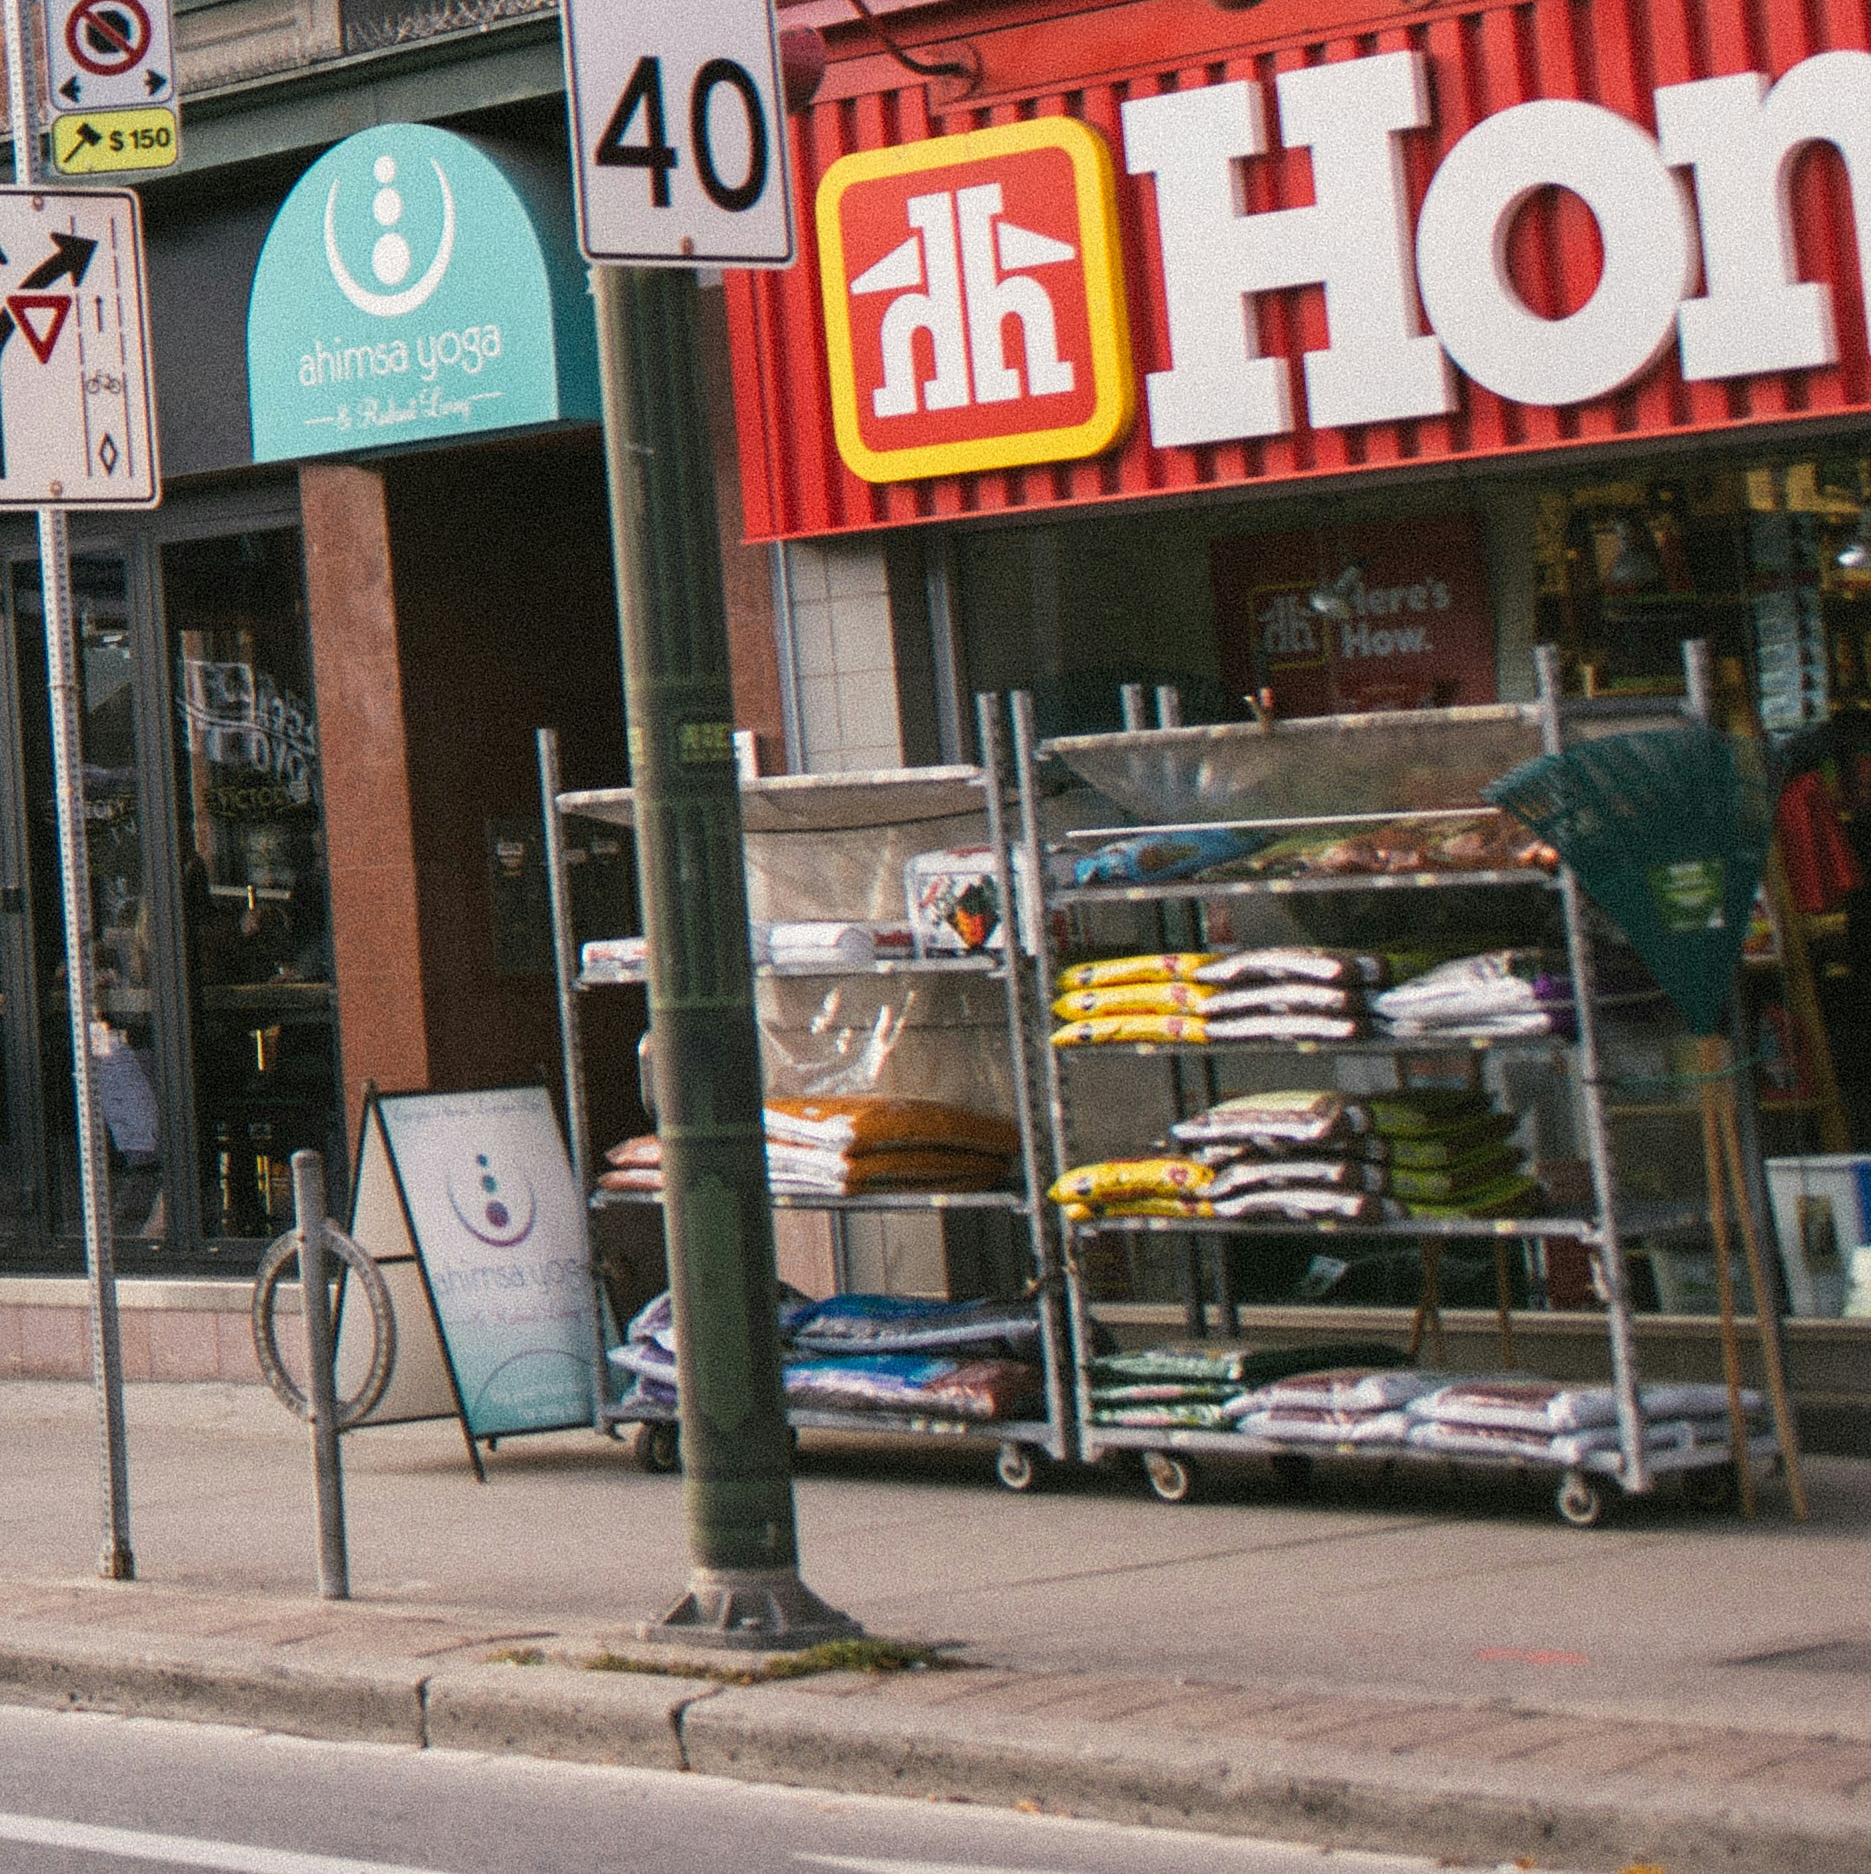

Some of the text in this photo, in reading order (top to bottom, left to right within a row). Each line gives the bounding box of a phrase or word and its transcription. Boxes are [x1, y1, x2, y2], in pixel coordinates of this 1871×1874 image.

[593, 54, 770, 213] 40
[299, 324, 502, 387] ahimsa yoga
[1340, 622, 1435, 659] How.
